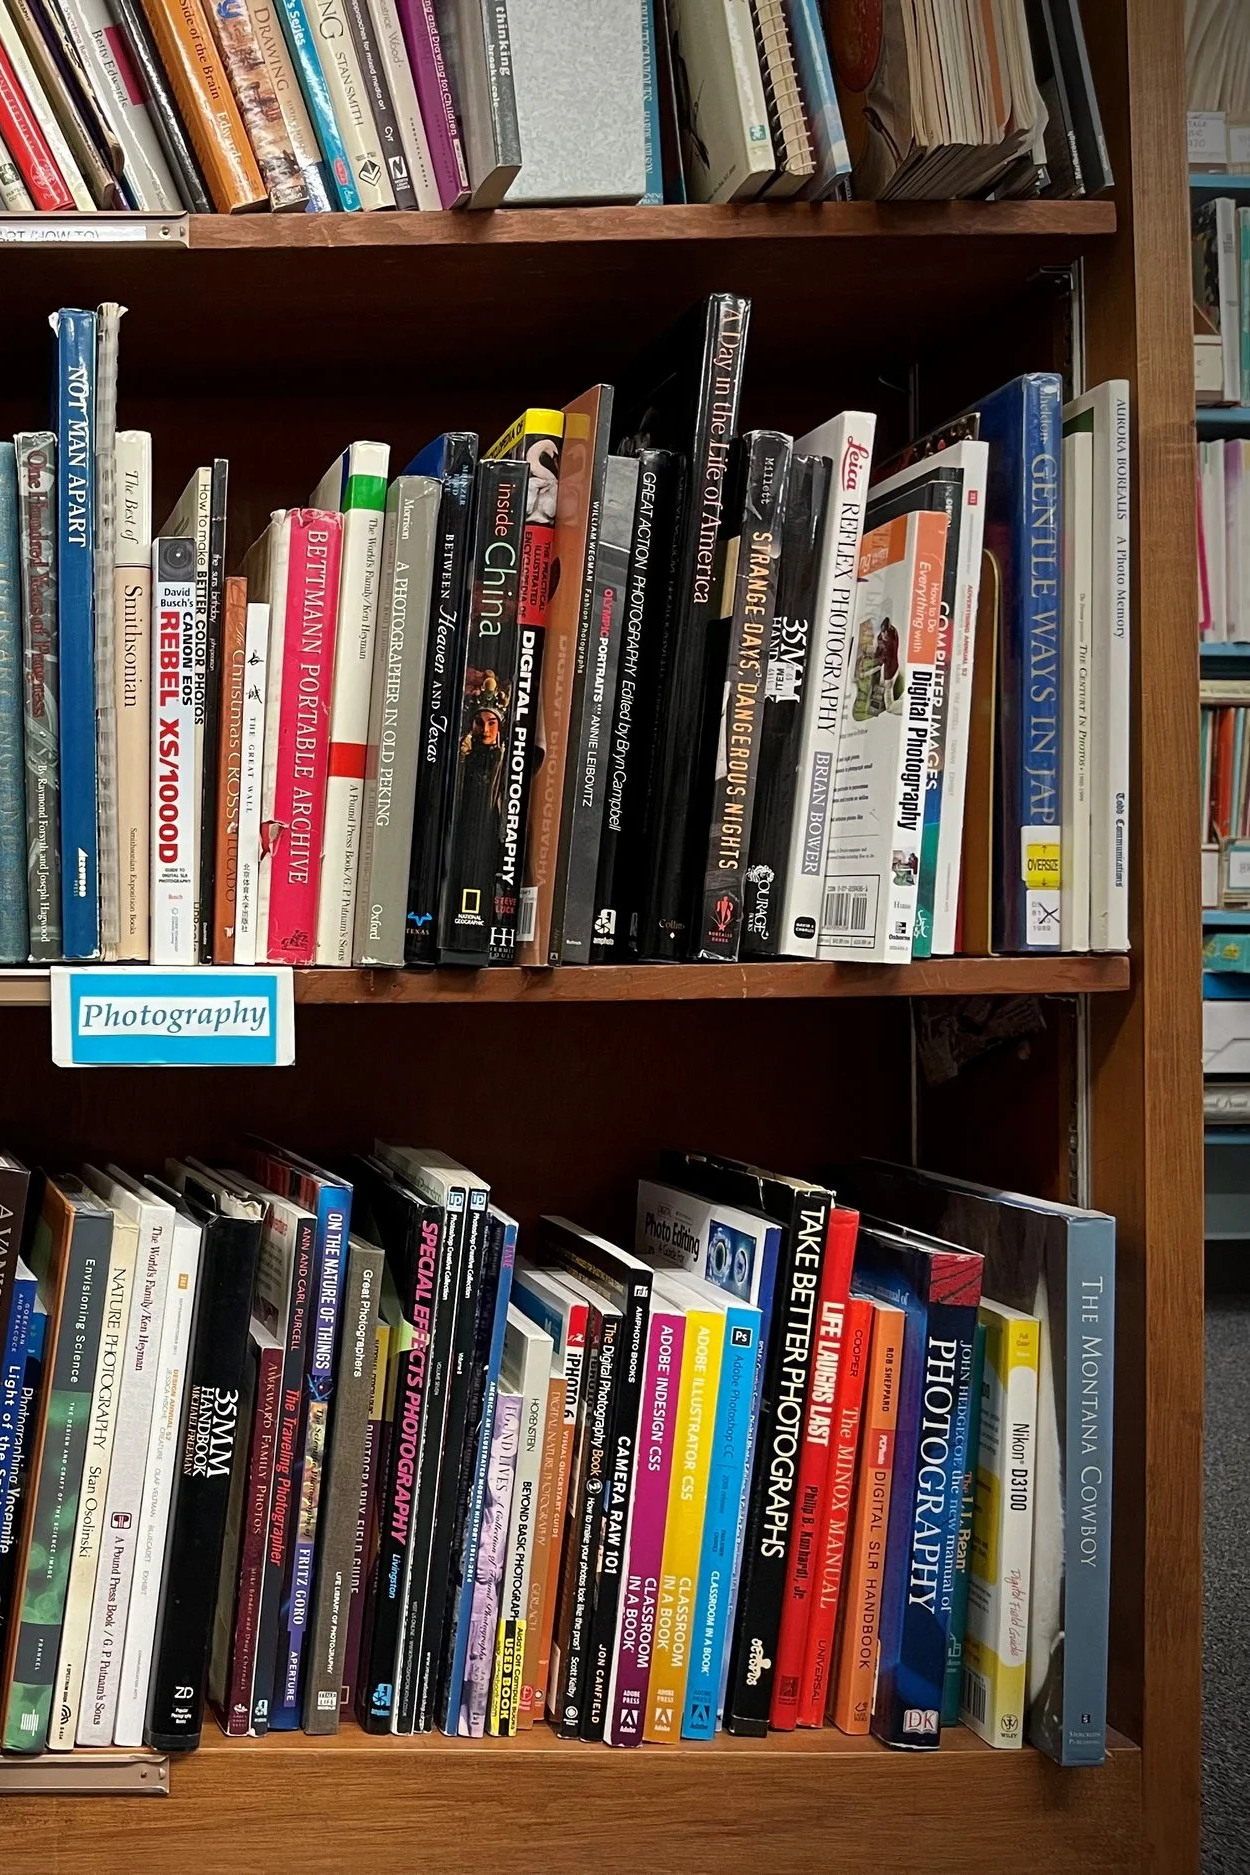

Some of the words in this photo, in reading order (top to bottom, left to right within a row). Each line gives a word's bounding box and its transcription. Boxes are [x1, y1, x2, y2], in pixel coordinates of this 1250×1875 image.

[254, 7, 289, 92] DRAWING
[495, 6, 511, 76] thinking
[201, 63, 220, 101] Brain
[384, 126, 395, 142] Cyr
[68, 366, 88, 413] NOT
[67, 419, 86, 467] MAN
[844, 436, 868, 491] Leica
[69, 475, 87, 547] APART
[493, 483, 515, 537] inside
[1115, 457, 1128, 520] BOREALIS
[401, 499, 414, 539] Morrison
[1116, 536, 1127, 546] A
[302, 529, 329, 654] BETTMANN
[396, 561, 408, 571] A
[478, 542, 517, 638] China
[742, 532, 772, 615] STRANGE
[1116, 548, 1127, 585] Photo
[386, 578, 408, 704] PHOTOGRAPHER
[1114, 589, 1126, 639] Memory
[124, 585, 142, 707] Smithsonian
[160, 610, 179, 706] REBEL
[738, 623, 763, 675] DAYS,
[515, 631, 535, 721] DIGITAL
[293, 663, 319, 779] PORTABLE
[386, 709, 400, 726] IN
[726, 682, 756, 796] DANGEROUS
[381, 731, 397, 763] OLD
[158, 718, 179, 864] XS/1000D
[376, 768, 394, 826] PEKING
[501, 727, 528, 885] PHOTOGRAPHY
[810, 754, 830, 806] BRIAN
[288, 786, 309, 885] ARCHIVE
[718, 803, 746, 869] NIGHTS
[803, 811, 824, 873] BOWER
[1027, 860, 1060, 872] OVERSIZE
[369, 904, 384, 939] Oxford
[82, 1000, 267, 1033] Photography
[326, 1234, 340, 1255] THE
[328, 1213, 343, 1231] ON
[795, 1206, 825, 1268] TAKE
[321, 1258, 338, 1304] NATURE
[361, 1269, 373, 1298] Great
[415, 1220, 438, 1301] SPECIAL
[75, 1259, 96, 1330] Envisioning
[320, 1307, 335, 1323] OF
[784, 1272, 816, 1362] BETTER
[820, 1301, 844, 1337] LIFE
[1081, 1277, 1103, 1323] THE
[70, 1335, 86, 1383] Science
[315, 1326, 332, 1369] THINGS
[353, 1301, 370, 1377] Photographers
[407, 1304, 430, 1387] EFFECTS
[851, 1329, 863, 1377] COOPER
[813, 1340, 840, 1404] LAUGHS
[1081, 1336, 1103, 1454] MONTANA
[807, 1406, 833, 1447] LAST
[840, 1407, 859, 1438] The
[1011, 1423, 1029, 1460] Nikon
[87, 1466, 101, 1494] Stan
[390, 1390, 421, 1546] PHOTOGRAPHY
[612, 1436, 631, 1504] CAMERA
[760, 1366, 803, 1558] PHOTOGRAPHS
[832, 1445, 854, 1513] MINOX
[908, 1336, 958, 1614] PHOTOGRAPHY
[1010, 1468, 1027, 1511] D3100
[79, 1497, 97, 1558] Osolinski
[608, 1510, 623, 1546] RAW
[871, 1472, 886, 1532] DIGITAL
[1080, 1466, 1102, 1568] COWBOY
[605, 1551, 619, 1574] 101
[820, 1519, 844, 1609] MANUAL
[868, 1541, 880, 1570] SLR
[859, 1579, 877, 1669] HANDBOOK
[287, 1651, 298, 1701] APERTURE
[597, 1645, 607, 1666] JON
[812, 1640, 826, 1704] UNIVERSAL
[592, 1669, 604, 1723] CANFIELD
